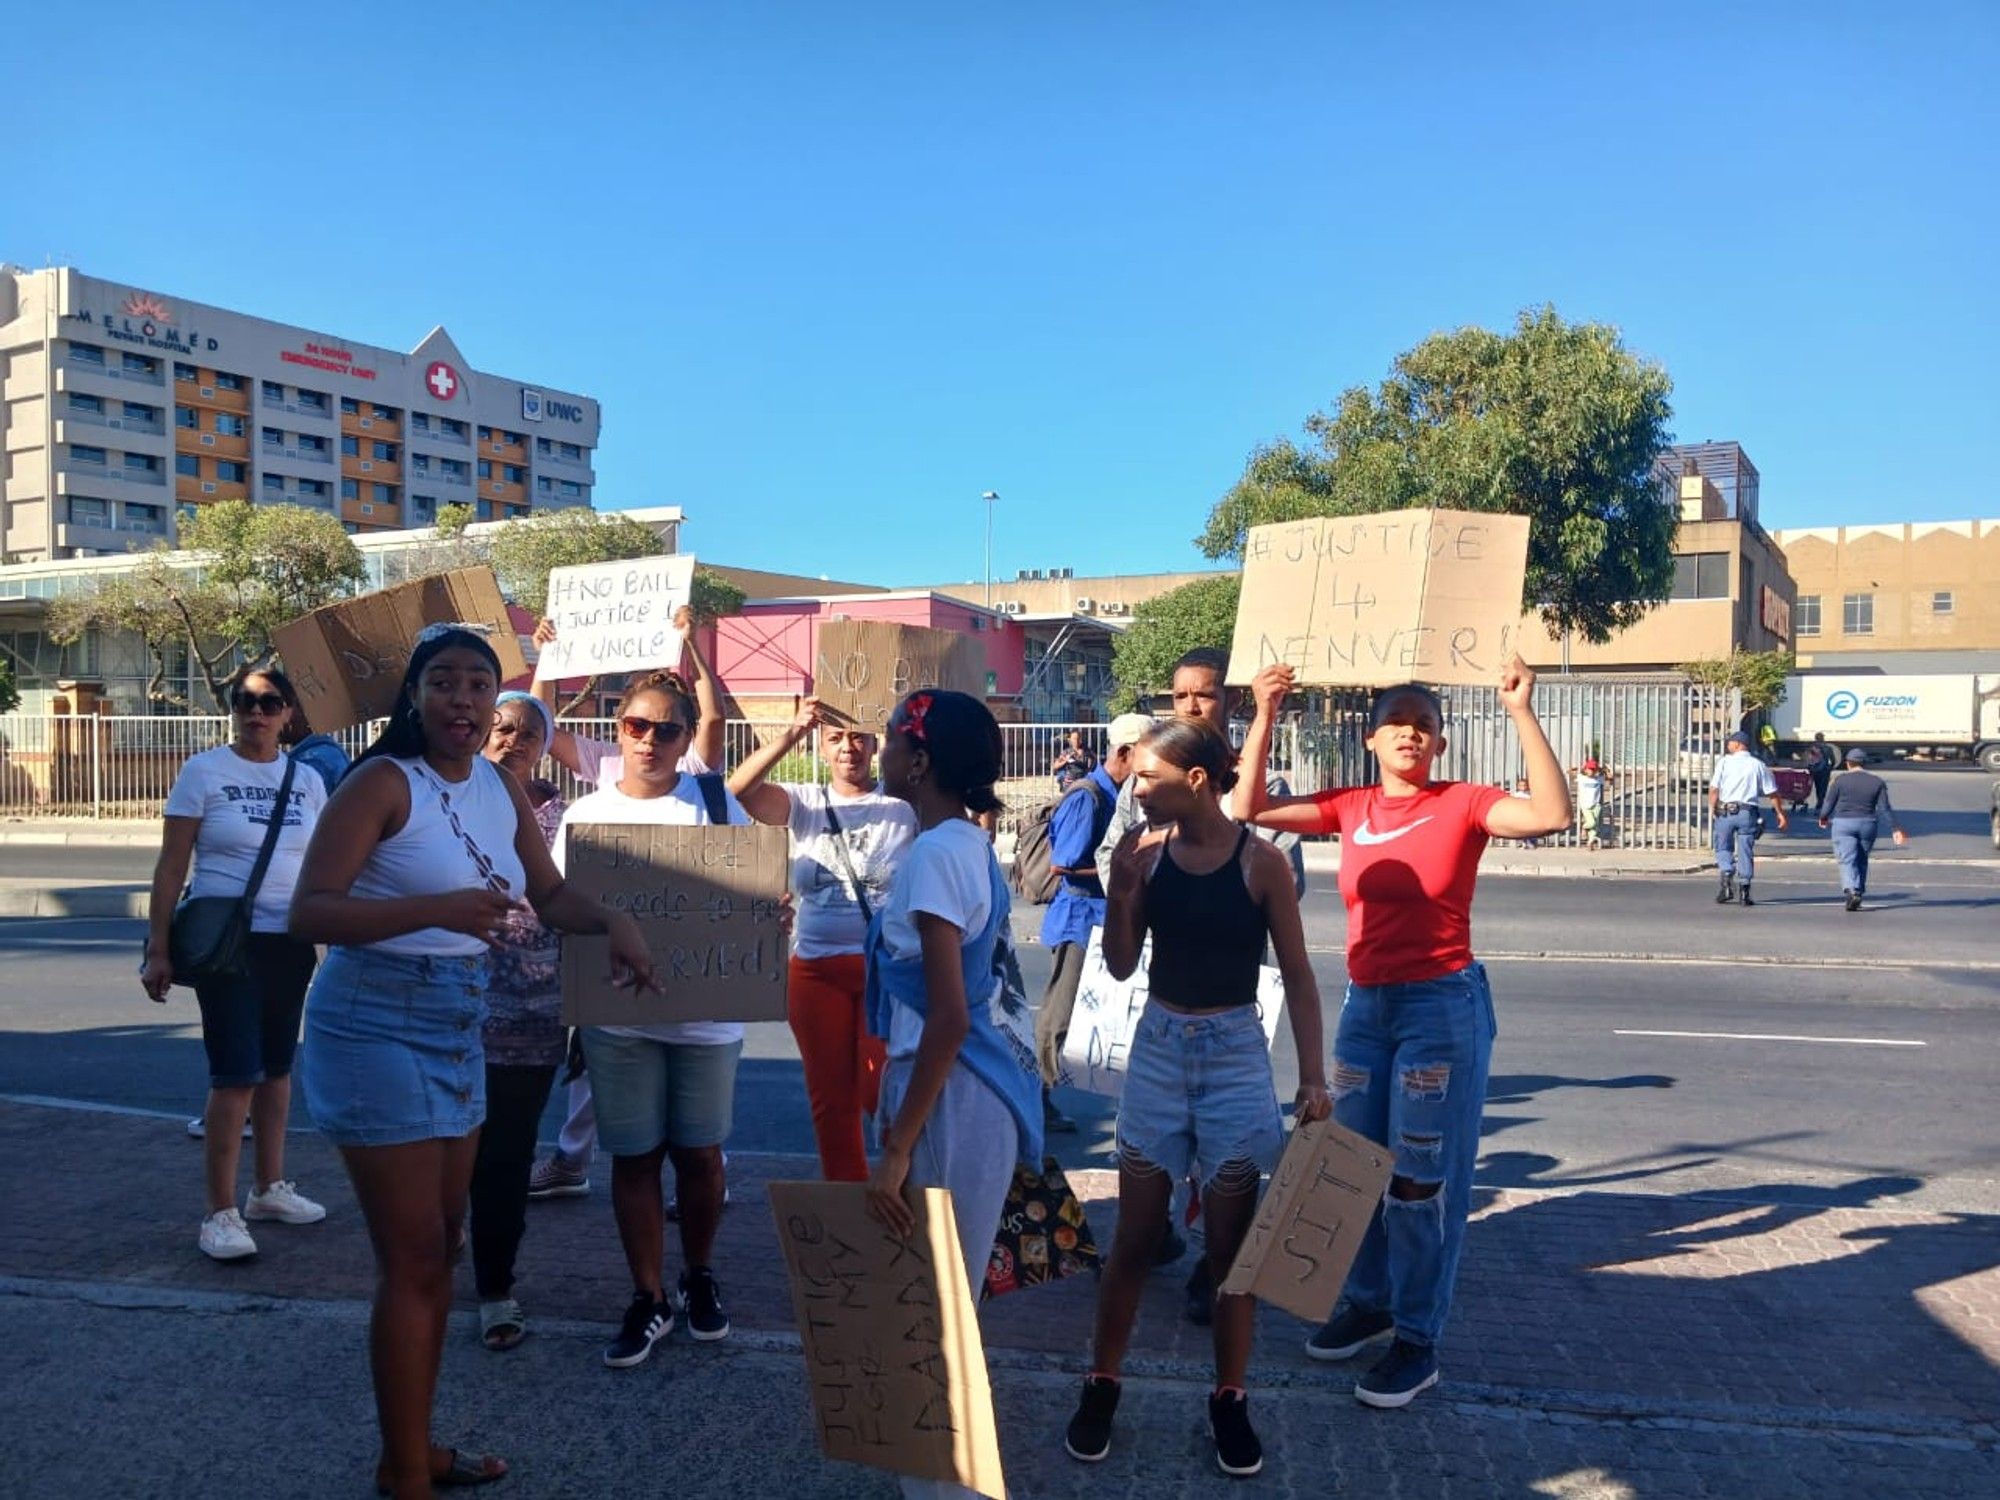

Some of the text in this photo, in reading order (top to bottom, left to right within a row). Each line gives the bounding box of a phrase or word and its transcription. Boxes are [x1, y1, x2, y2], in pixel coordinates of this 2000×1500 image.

[281, 351, 349, 374] EMERGENCY
[546, 400, 582, 423] UWC
[624, 570, 681, 596] BAIL
[1332, 575, 1376, 619] 4
[818, 652, 871, 691] NO
[1863, 696, 1917, 707] FUZION
